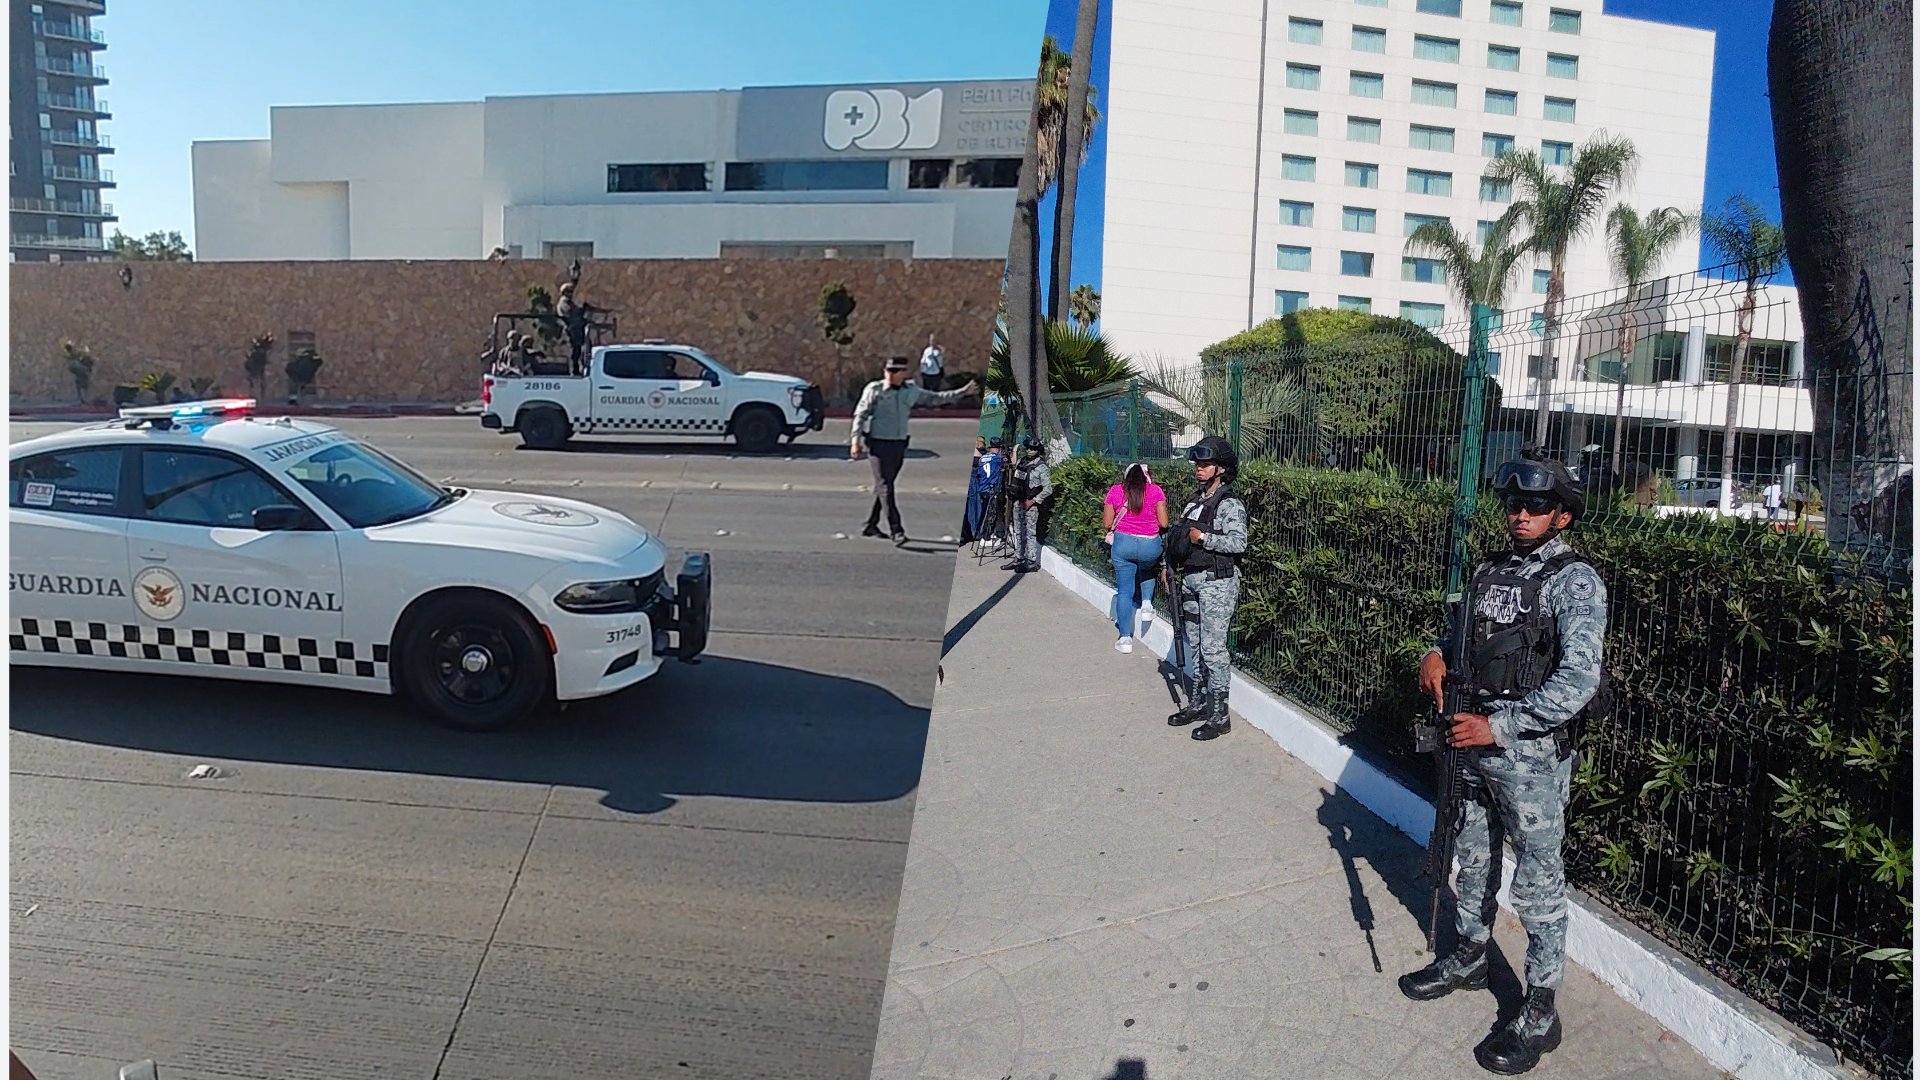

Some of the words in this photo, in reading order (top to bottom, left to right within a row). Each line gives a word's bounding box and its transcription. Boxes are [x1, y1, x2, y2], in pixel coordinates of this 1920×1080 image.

[958, 119, 1027, 132] CENTRO
[957, 137, 979, 150] DE
[600, 395, 645, 405] GUARDIA
[668, 396, 720, 406] NACIONAL
[191, 583, 343, 612] NACIONAL
[606, 624, 641, 643] 31748
